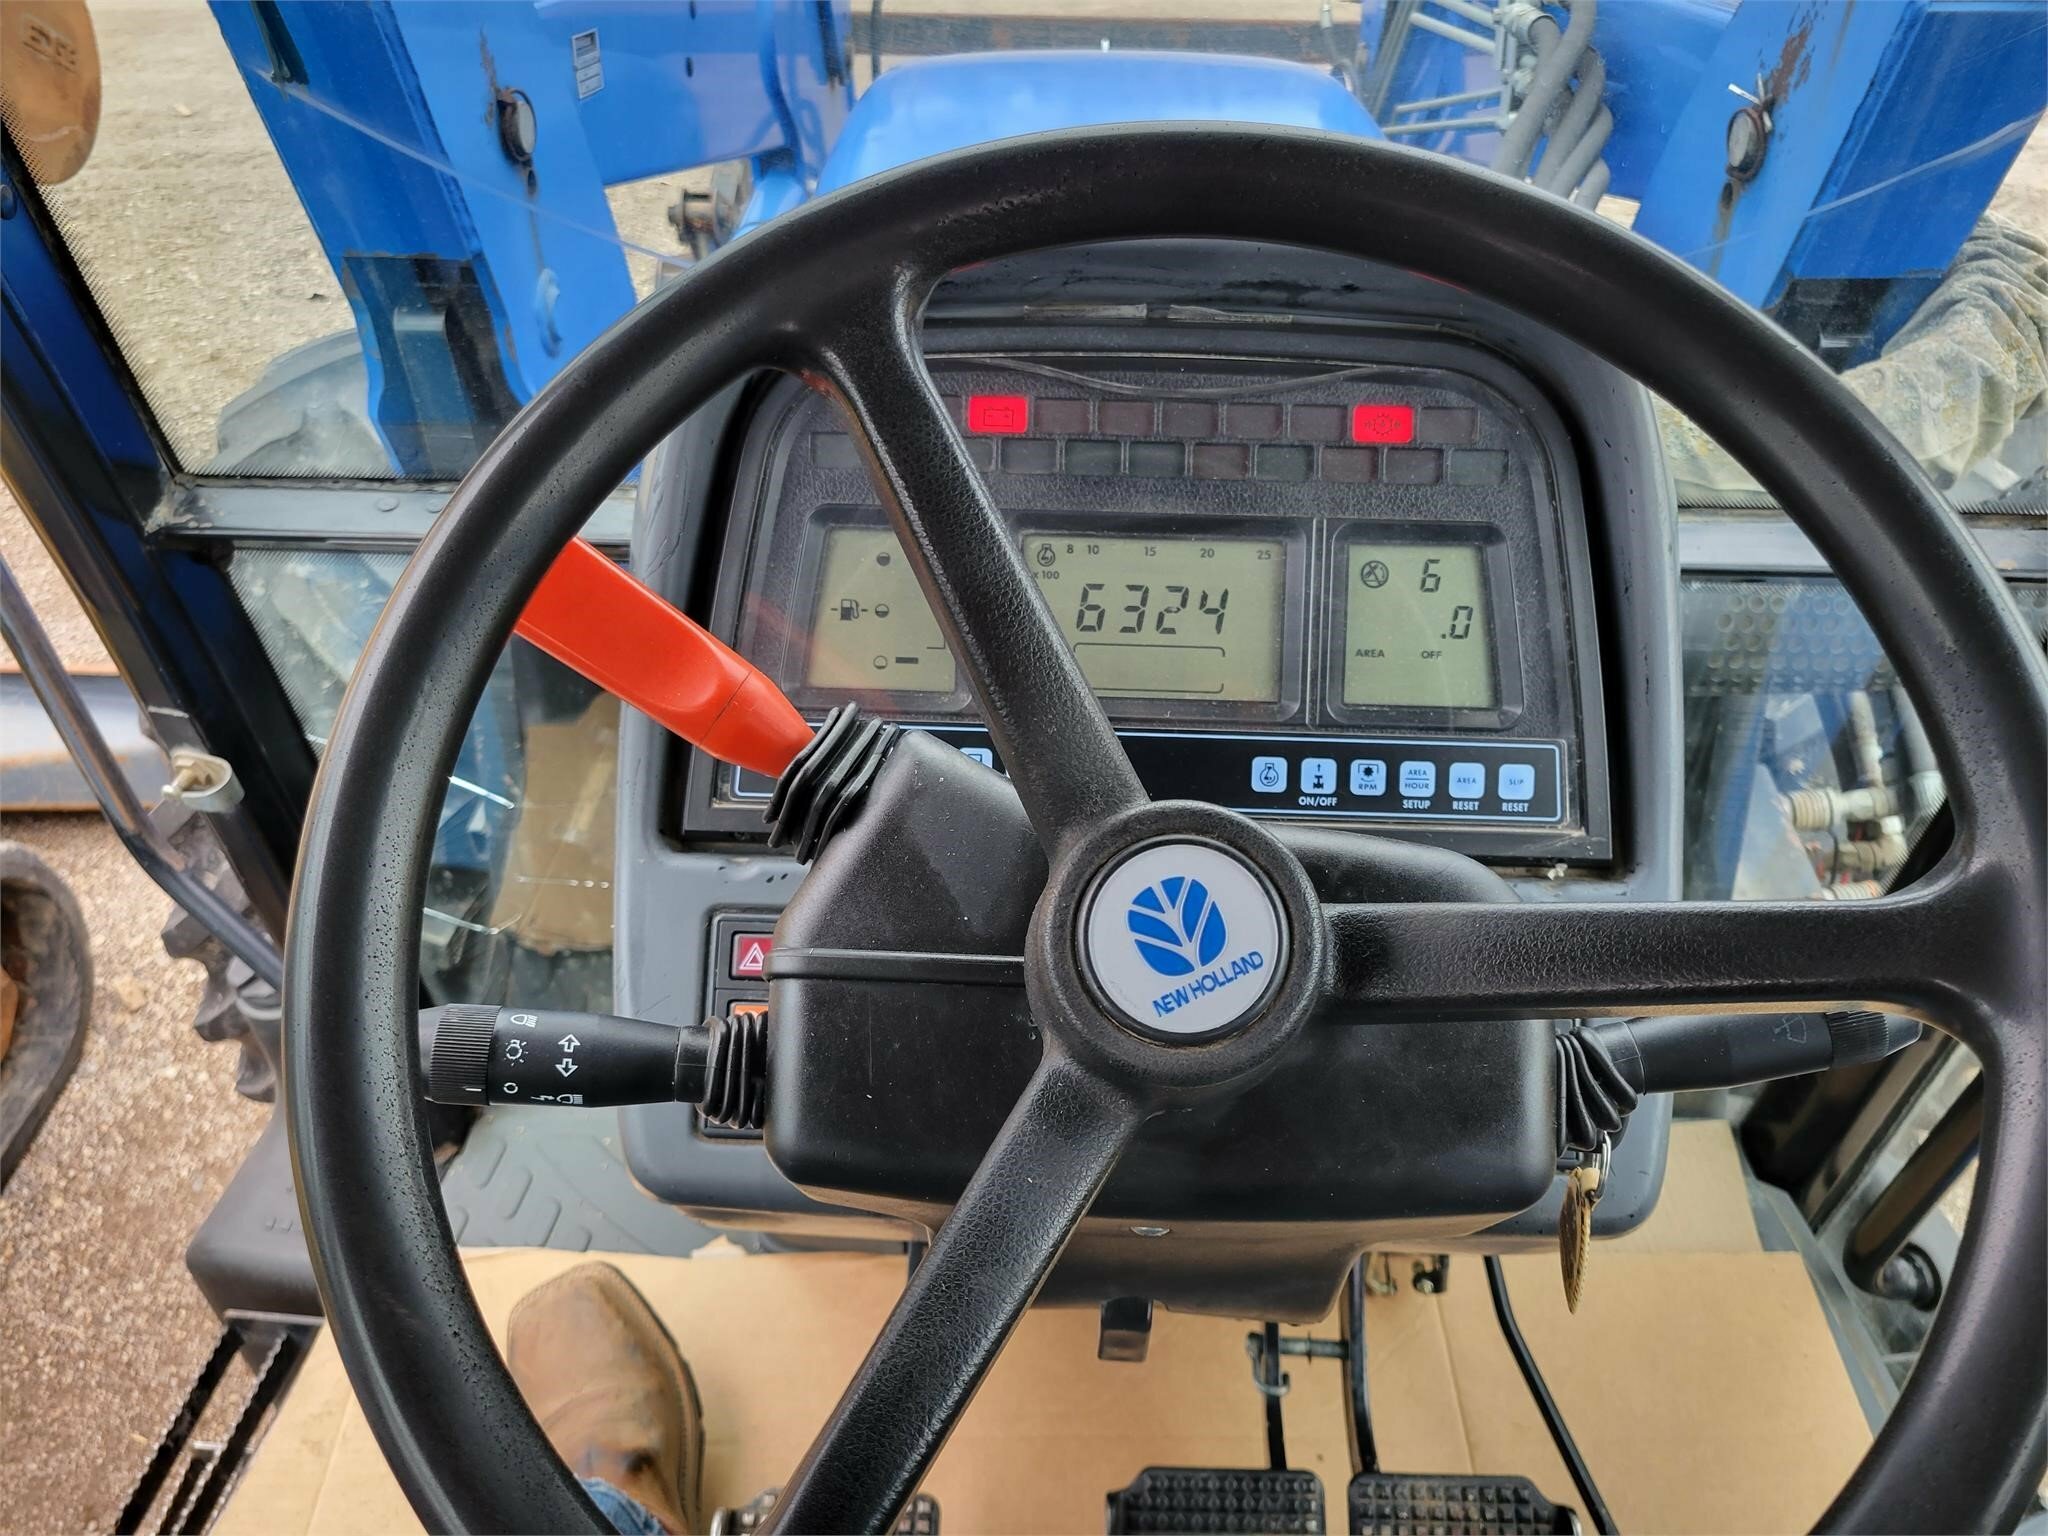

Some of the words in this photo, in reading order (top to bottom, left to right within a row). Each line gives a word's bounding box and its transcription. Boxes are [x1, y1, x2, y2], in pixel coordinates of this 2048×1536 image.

[1066, 543, 1075, 554] 8
[1087, 544, 1100, 555] 10
[1143, 547, 1157, 557] 15
[1200, 548, 1215, 559] 20
[1256, 549, 1272, 560] 25
[1042, 570, 1060, 580] 100
[1419, 558, 1442, 593] 6
[1075, 583, 1229, 635] 6324
[1355, 649, 1386, 659] AREA
[1421, 650, 1443, 660] OFF
[1407, 768, 1428, 777] AREA
[1404, 782, 1430, 790] HOUR
[1456, 777, 1477, 785] AREA
[1358, 783, 1378, 791] RPM
[1298, 796, 1338, 807] ON/OFF
[1402, 799, 1431, 810] SETUP
[1452, 800, 1480, 811] RESET
[1502, 802, 1529, 813] RESET
[1152, 985, 1190, 1018] NEW
[1190, 950, 1265, 1000] HOLLAND
